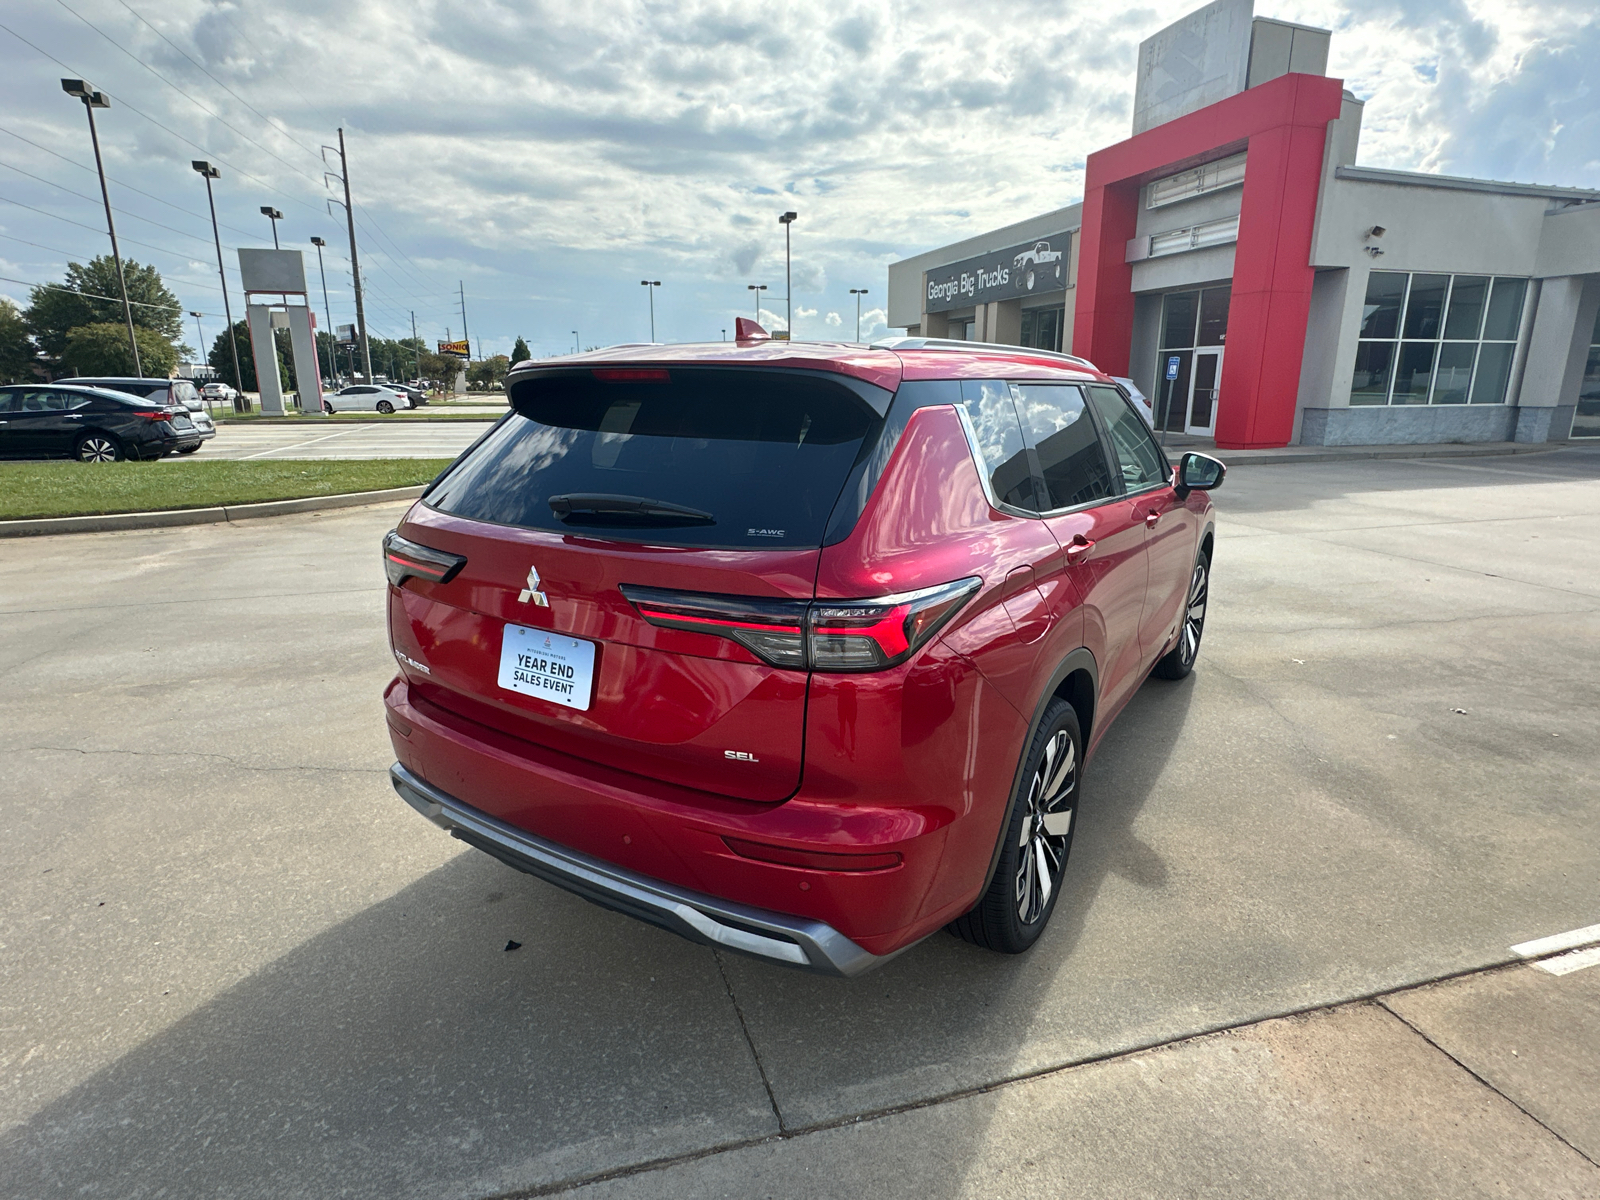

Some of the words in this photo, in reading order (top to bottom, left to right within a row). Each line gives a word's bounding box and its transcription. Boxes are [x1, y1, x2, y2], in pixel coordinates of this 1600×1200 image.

[928, 276, 958, 301] Georgia
[961, 272, 974, 297] Big
[977, 264, 1009, 289] Trucks
[441, 343, 467, 351] SONIC
[748, 528, 785, 536] S-AWC
[517, 653, 547, 672] YEAR
[550, 662, 574, 679] END
[514, 670, 541, 687] SALES
[543, 678, 574, 695] EVENT
[724, 750, 759, 763] SEL
